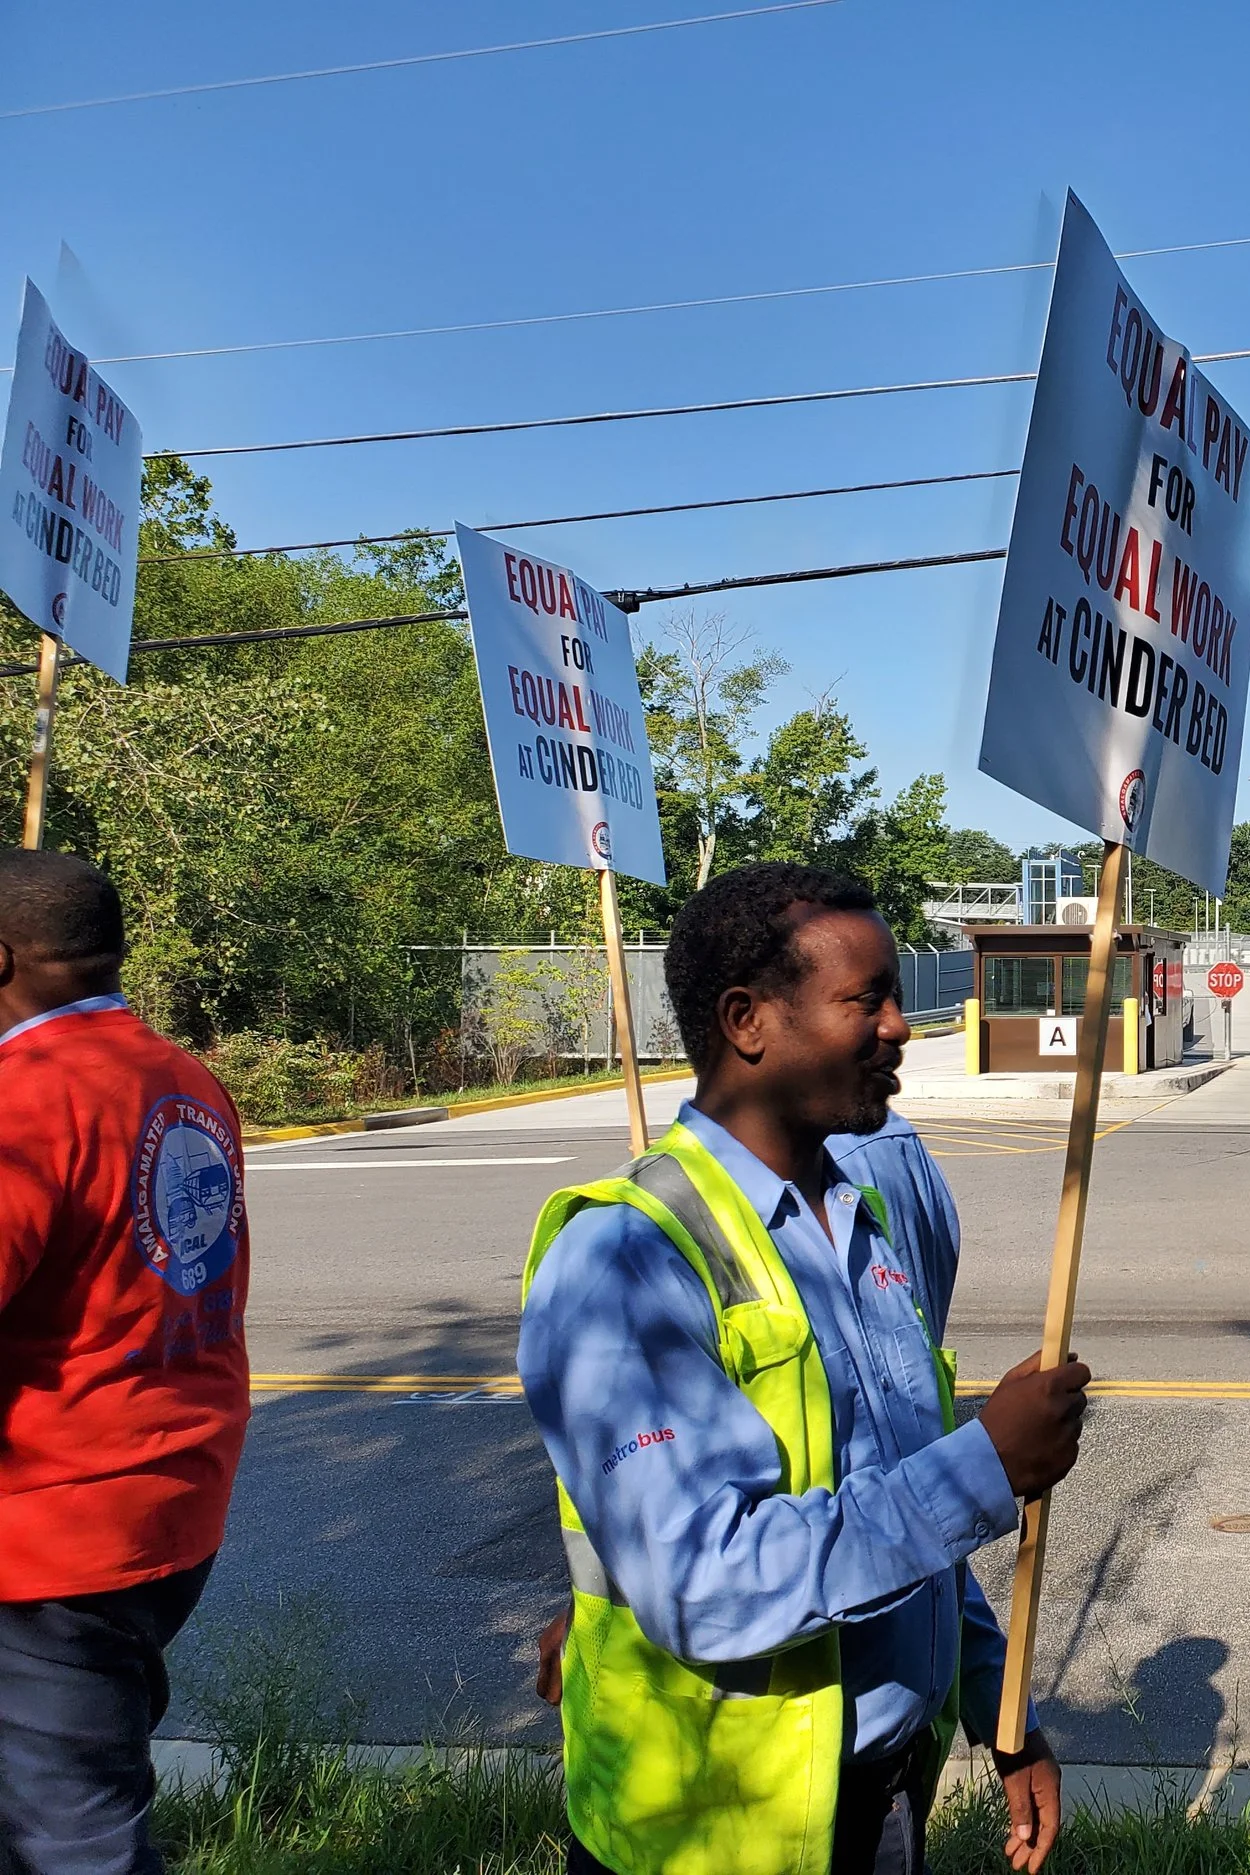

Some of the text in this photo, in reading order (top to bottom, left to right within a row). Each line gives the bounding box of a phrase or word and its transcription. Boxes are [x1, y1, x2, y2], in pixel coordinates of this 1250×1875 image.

[45, 323, 125, 446] EQUAL PAY
[1106, 283, 1248, 503] EQUAL PAY
[66, 415, 92, 463] FOR
[22, 420, 124, 555] EQUAL WORK
[1148, 453, 1196, 537] FOR
[13, 490, 122, 607] AT CINDER BED
[1060, 462, 1238, 688] EQUAL WORK
[504, 552, 608, 643] EQUAL PAY
[561, 634, 594, 675] FOR
[1037, 596, 1228, 776] AT CINDER BED
[507, 665, 635, 754] EQUAL WORK
[518, 735, 643, 810] AT CINDER BED
[1210, 973, 1242, 988] STOP
[1049, 1026, 1067, 1047] A
[176, 1103, 235, 1158] TRANSIT
[180, 1233, 208, 1257] CAL
[182, 1262, 207, 1290] 689
[602, 1427, 676, 1475] metrobus
